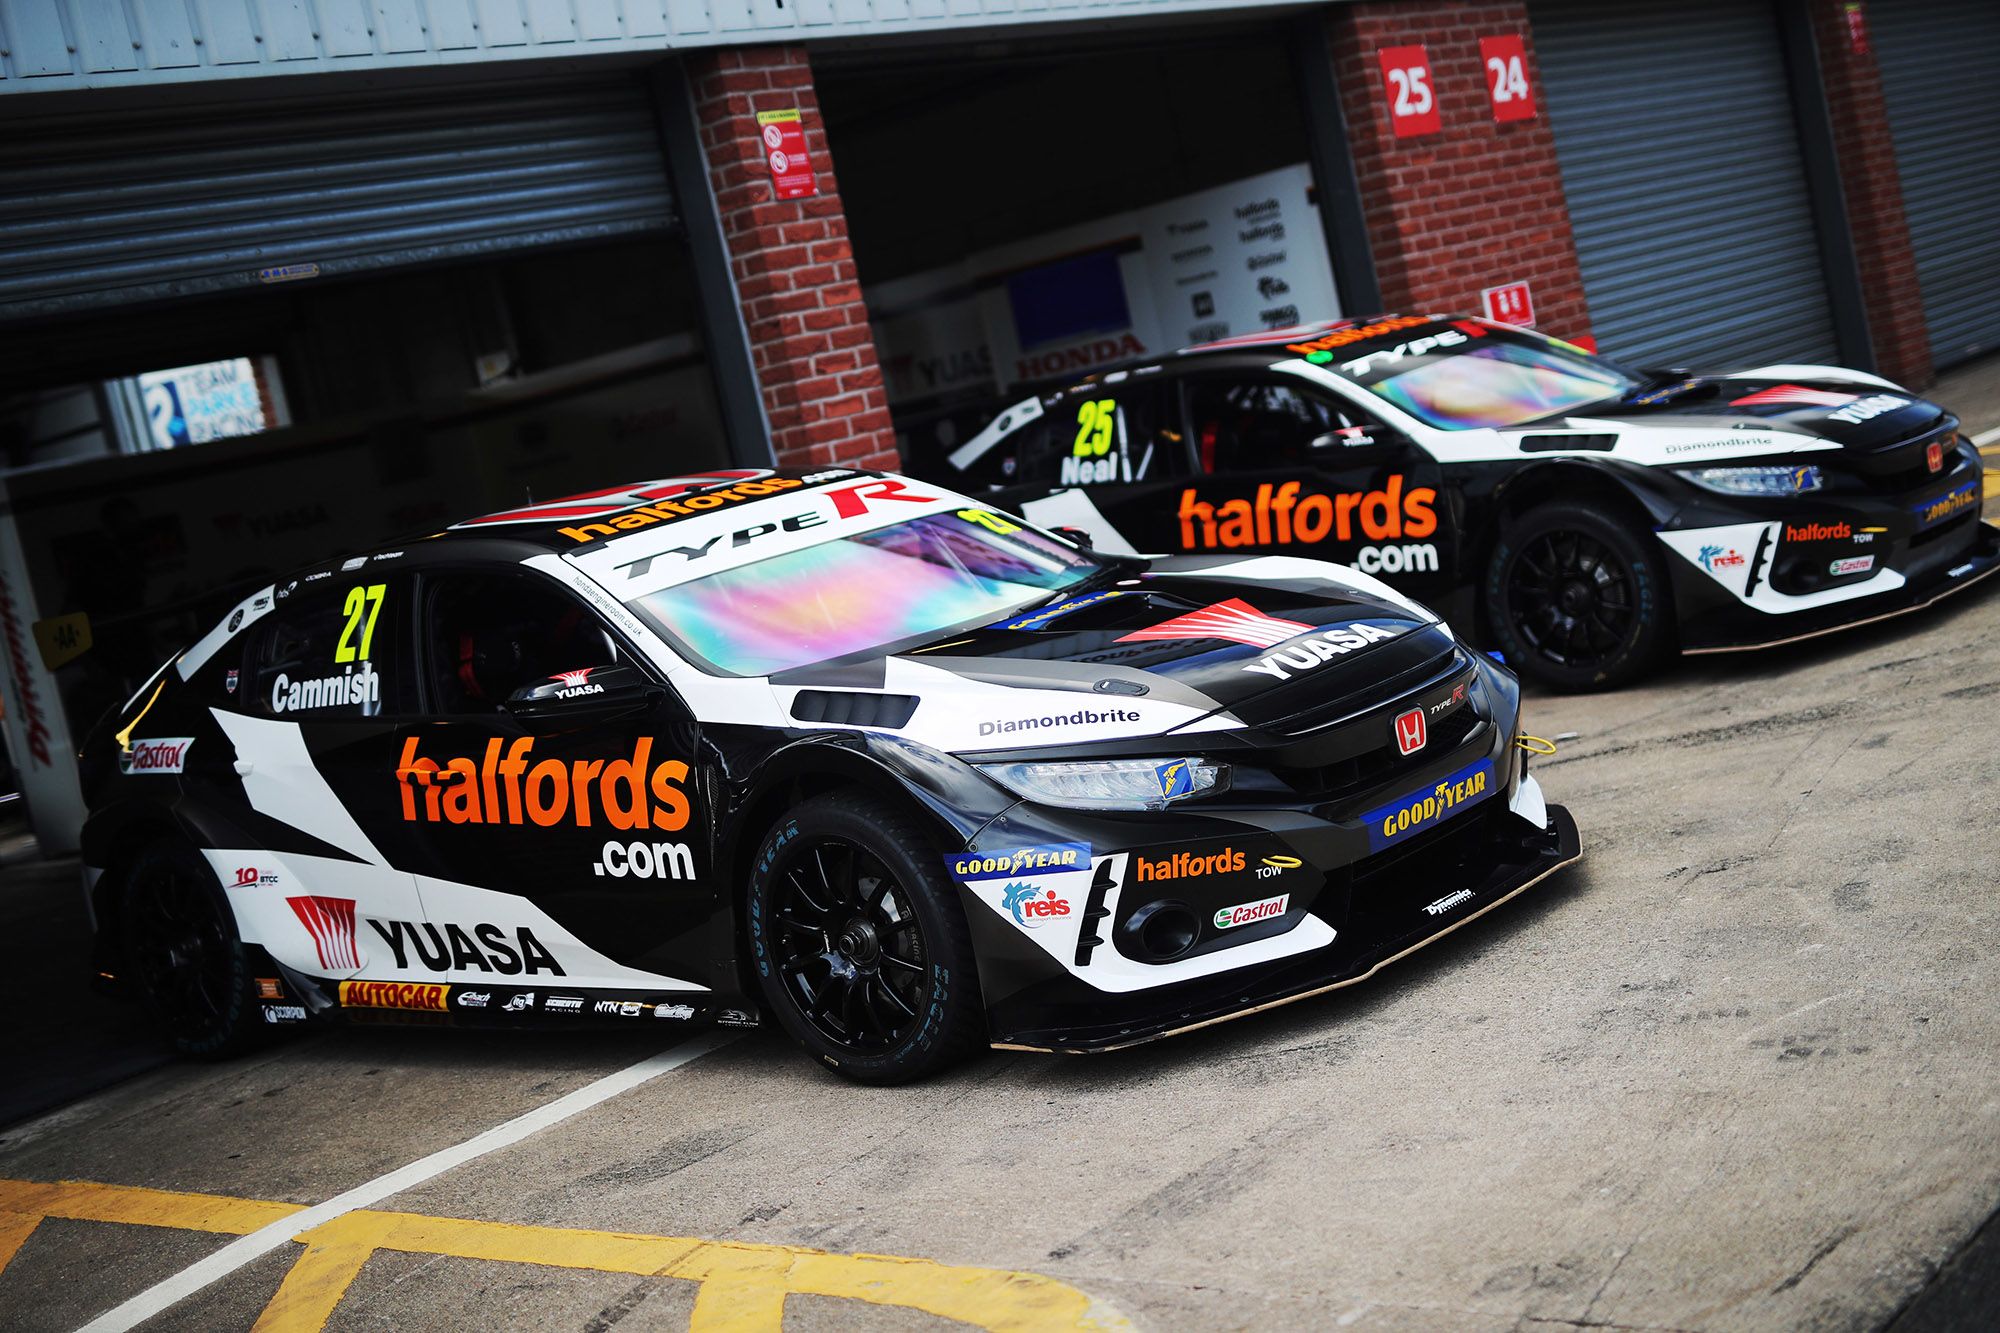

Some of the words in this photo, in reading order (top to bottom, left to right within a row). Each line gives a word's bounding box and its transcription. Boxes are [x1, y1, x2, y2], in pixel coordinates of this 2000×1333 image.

[1388, 66, 1432, 116] 25
[1487, 55, 1528, 103] 24
[1018, 334, 1146, 380] HONDA
[1340, 330, 1467, 377] TYPE
[1073, 399, 1116, 457] 25
[1665, 437, 1773, 454] Diamondbrite
[1061, 451, 1118, 485] Neal
[1178, 474, 1438, 549] halfords
[613, 510, 828, 579] TYPE
[822, 480, 940, 519] R
[1786, 521, 1851, 542] halfords
[1853, 533, 1874, 543] TOW
[1349, 543, 1439, 573] .com
[1713, 549, 1745, 568] reis
[335, 583, 387, 664] 27
[572, 576, 643, 637] hondaengineroom.co.uk
[1242, 622, 1398, 682] YUASA
[271, 661, 379, 714] Cammish
[554, 683, 604, 700] YUASA
[1430, 697, 1453, 715] TYPE
[1453, 683, 1464, 703] R
[979, 708, 1141, 737] Diamondbrite
[132, 741, 187, 770] Castrol
[395, 736, 691, 832] halfords
[235, 867, 258, 884] 10
[593, 840, 696, 881] .com
[1137, 847, 1246, 882] halfords
[1255, 867, 1283, 880] TOW
[1025, 890, 1070, 918] reis
[1232, 899, 1284, 925] Castrol
[365, 918, 567, 977] YUASA
[346, 982, 443, 1010] AUTOCAR
[594, 1001, 619, 1014] NTN
